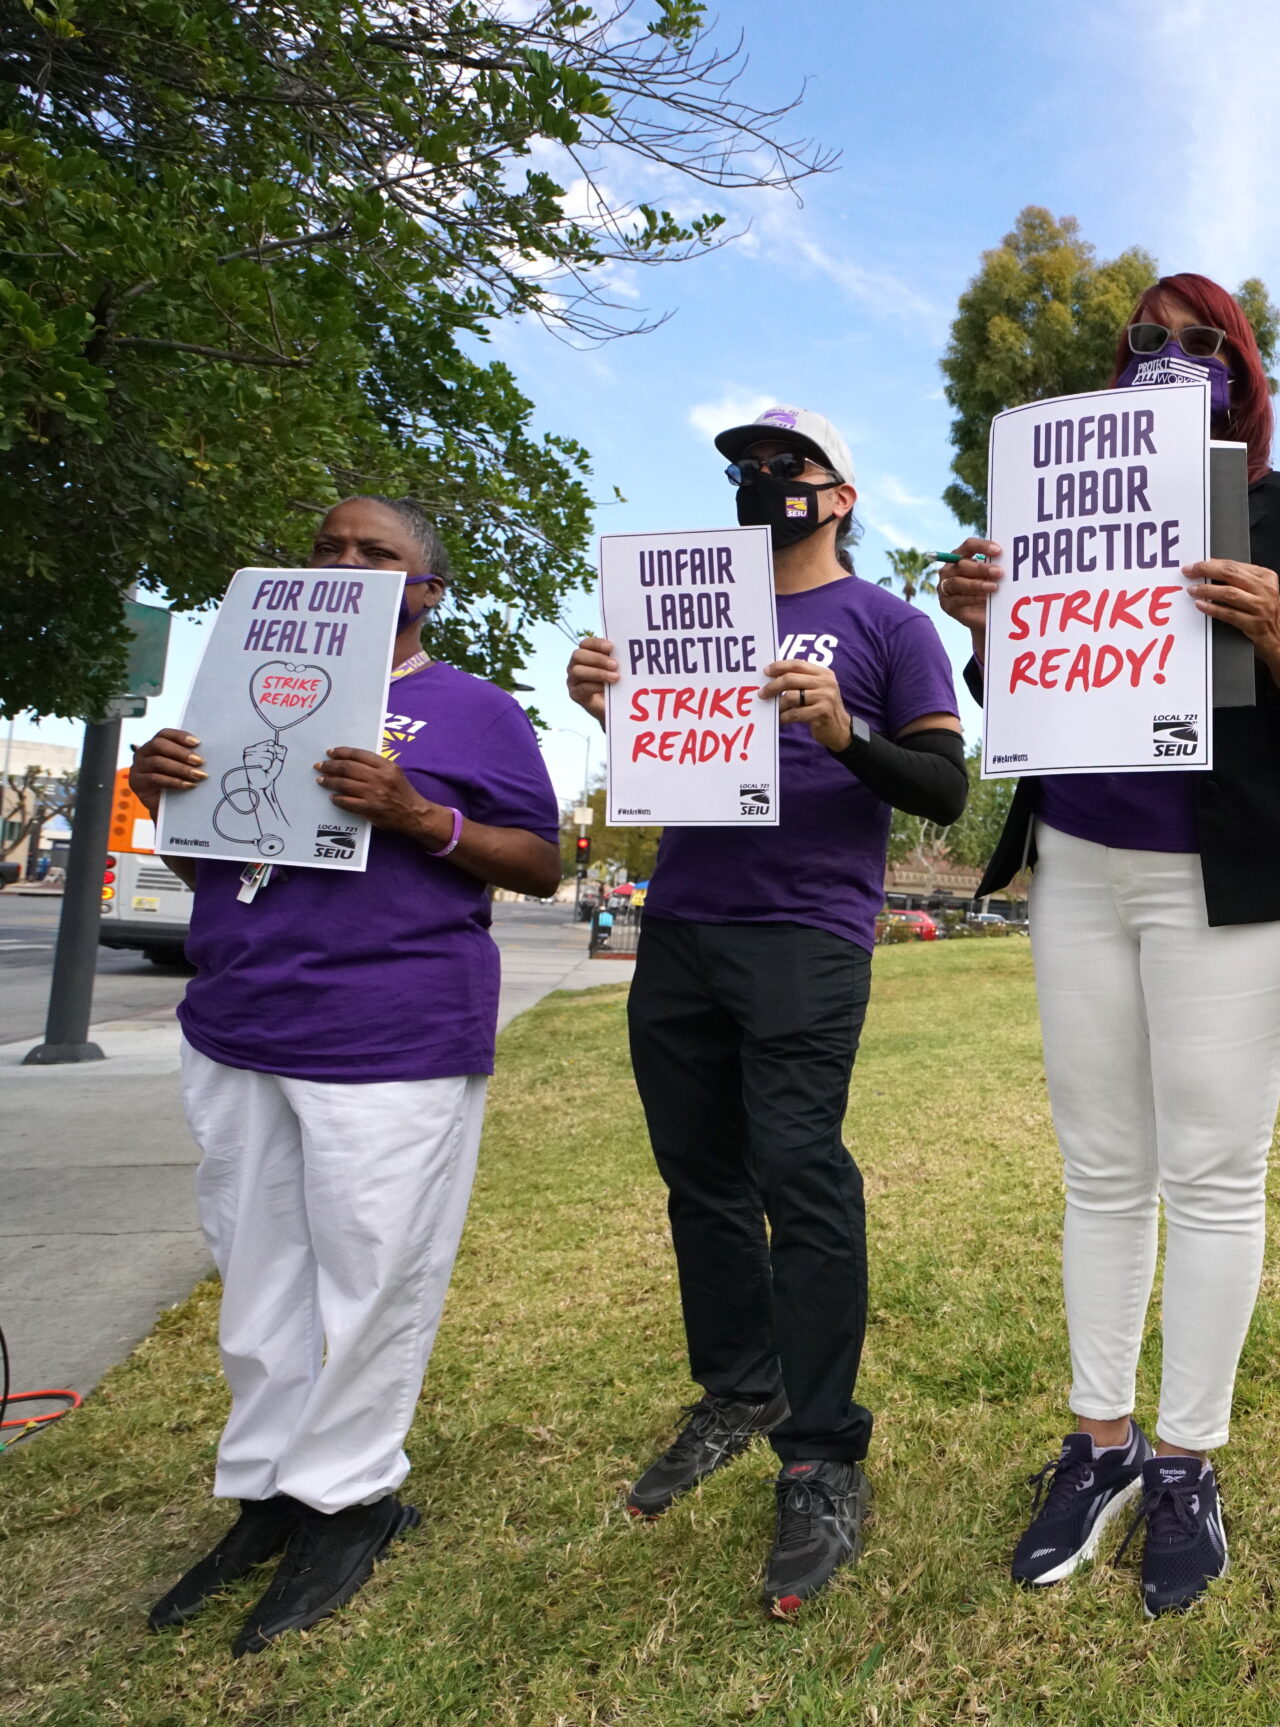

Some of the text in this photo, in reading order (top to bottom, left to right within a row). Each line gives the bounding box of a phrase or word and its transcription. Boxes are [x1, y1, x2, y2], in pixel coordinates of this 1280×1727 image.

[1137, 357, 1170, 374] PROTECT
[1131, 372, 1158, 385] ALL
[1033, 409, 1158, 468] UNFAIR
[1037, 465, 1153, 522] LABOR
[786, 510, 807, 518] SEIU
[1013, 520, 1180, 582] PRACTICE
[639, 547, 736, 587] UNFAIR
[252, 580, 364, 614] FOR OUR
[645, 591, 734, 631] LABOR
[1008, 585, 1184, 641] STRIKE
[243, 619, 348, 656] HEALTH
[628, 635, 757, 675] PRACTICE
[1009, 633, 1175, 695] READY!
[262, 675, 322, 692] STRIKE
[260, 692, 317, 708] READY!
[629, 686, 761, 722] STRIKE
[1153, 714, 1182, 722] LOCAL
[631, 723, 755, 765] READY!
[1153, 743, 1198, 757] SEIU
[992, 753, 1028, 764] #WeAreWatts
[617, 808, 651, 816] #WeAreWatts
[740, 806, 770, 815] SEIU
[317, 824, 342, 832] LOCAL
[169, 837, 210, 848] #WeAreWatts
[314, 847, 355, 860] SEIU
